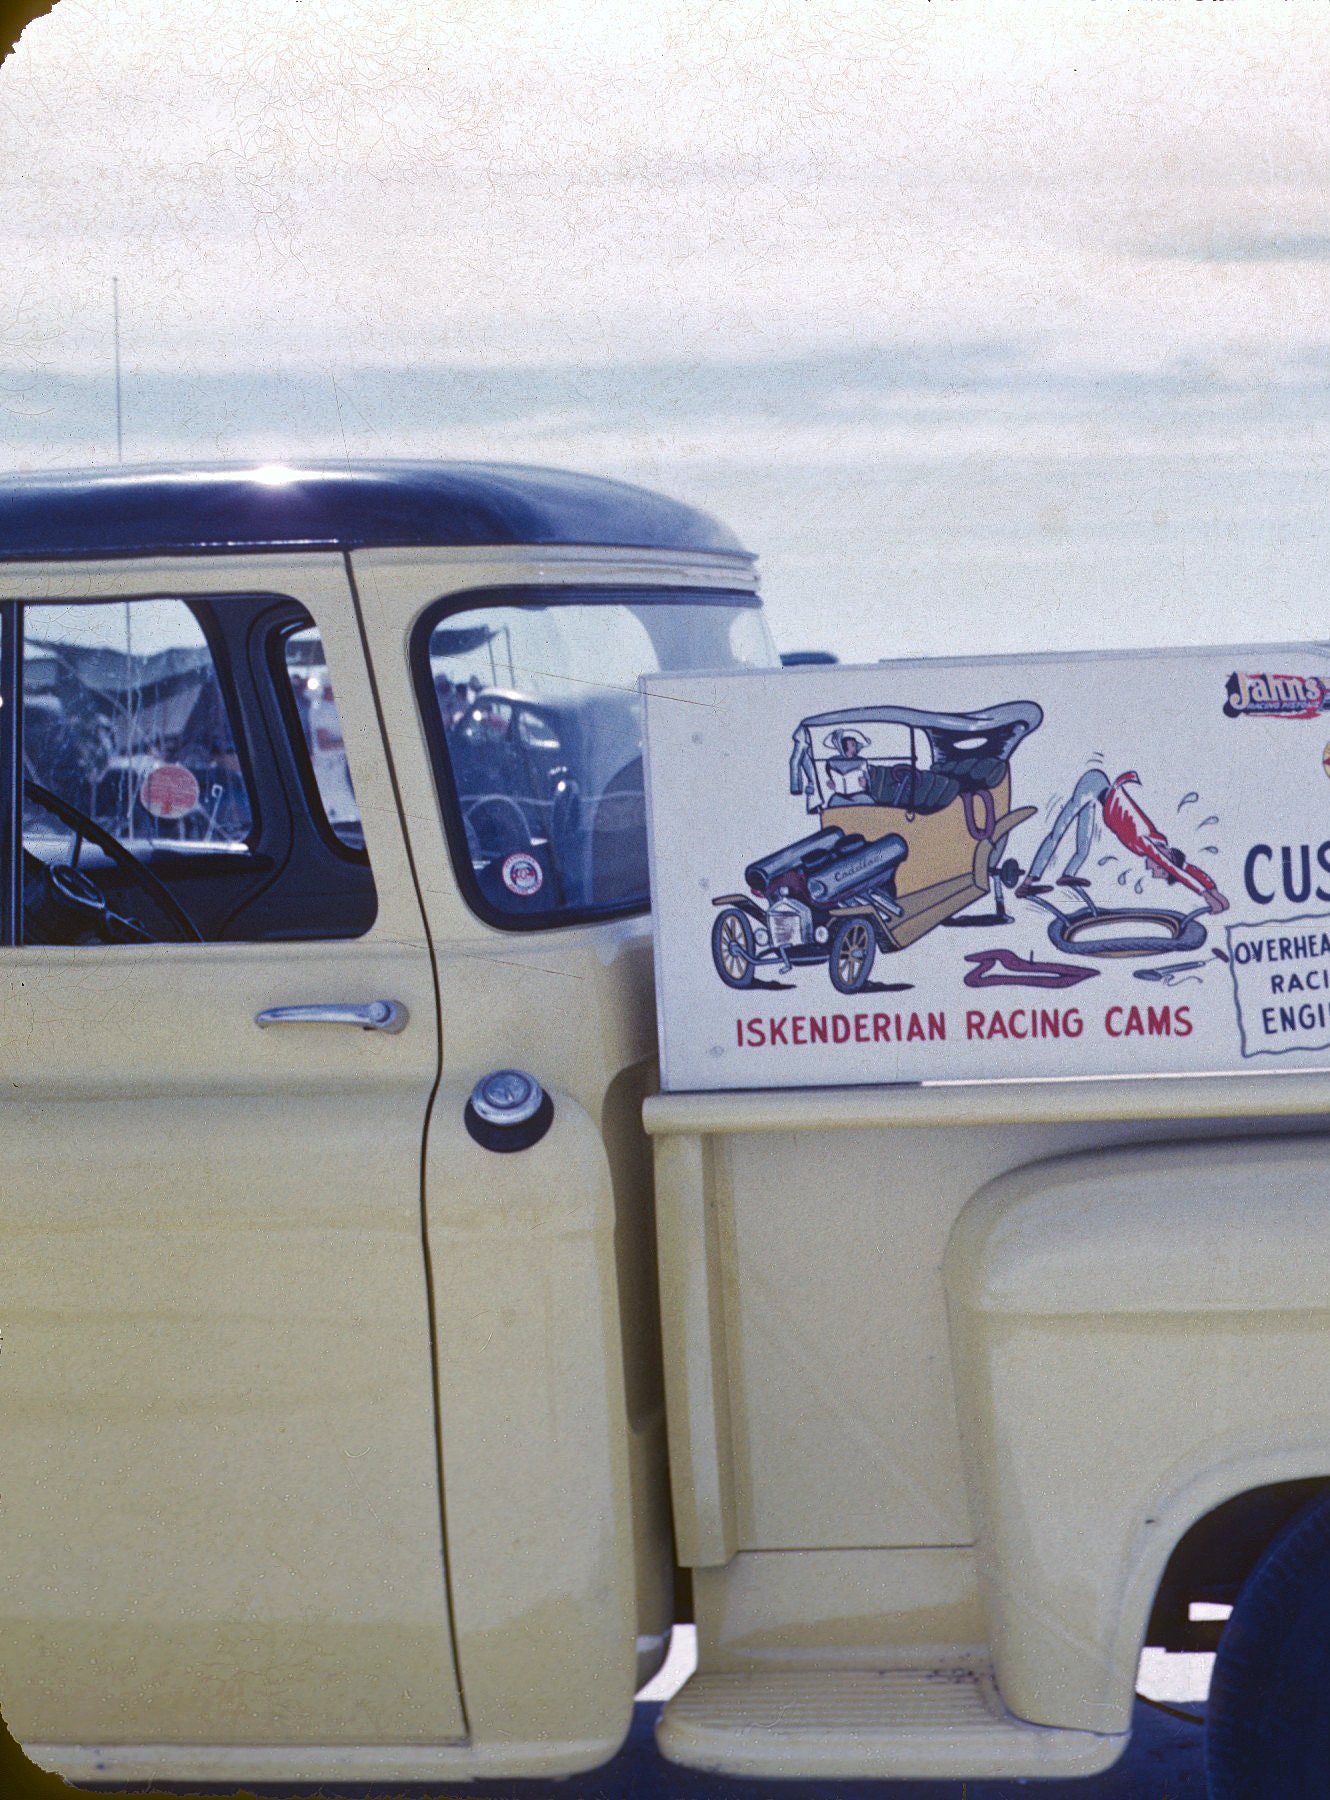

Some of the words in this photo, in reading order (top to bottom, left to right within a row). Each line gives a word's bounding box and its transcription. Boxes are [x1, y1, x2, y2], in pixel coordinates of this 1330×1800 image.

[737, 1011, 946, 1047] ISKENDERIAN
[967, 1007, 1083, 1040] RACING
[1105, 1005, 1193, 1037] CAMS
